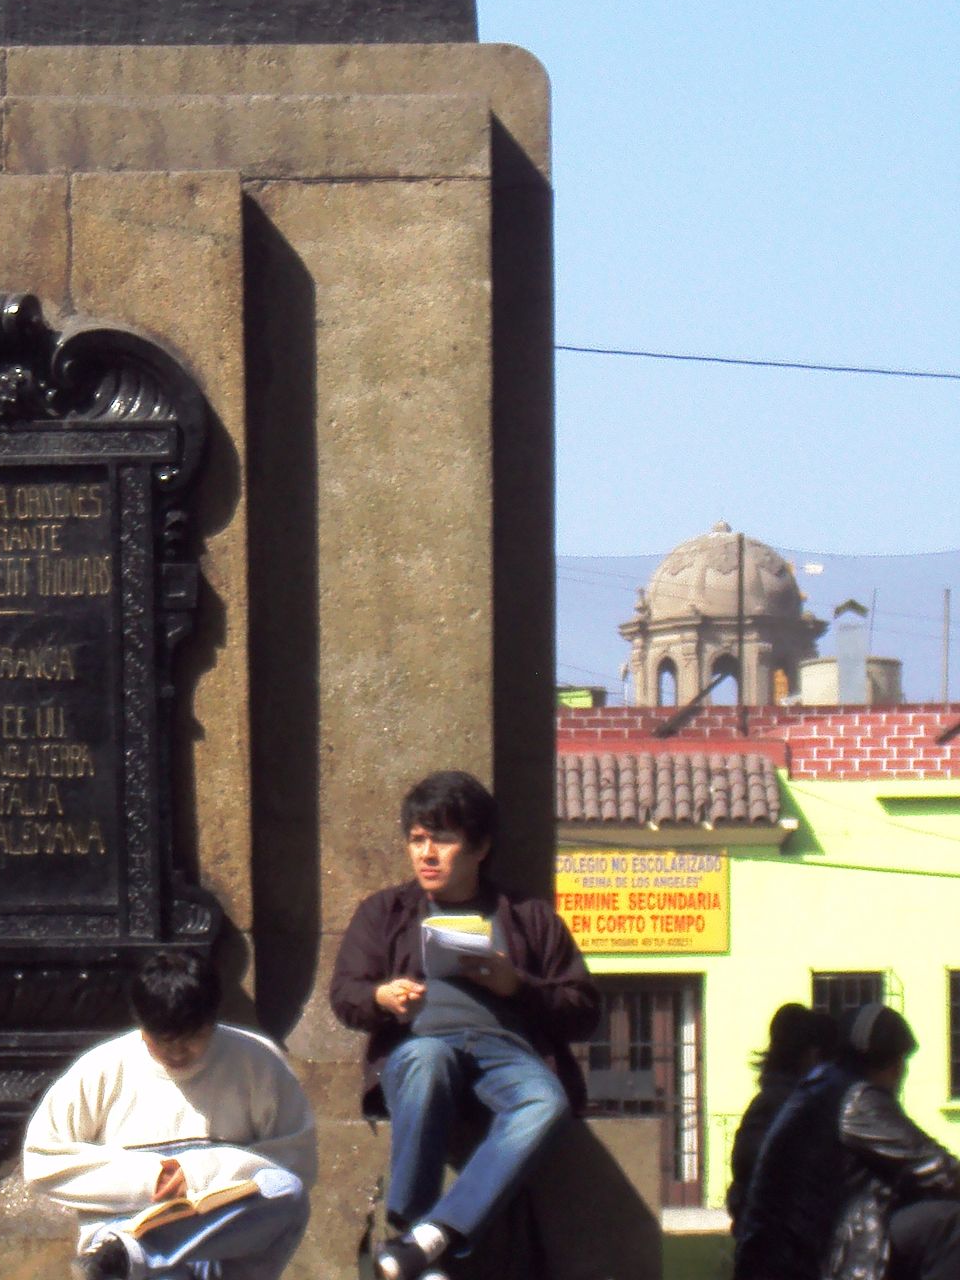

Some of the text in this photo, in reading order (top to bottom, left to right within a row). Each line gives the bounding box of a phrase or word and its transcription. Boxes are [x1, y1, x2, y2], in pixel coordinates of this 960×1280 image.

[555, 855, 722, 873] COLEGIO NO ESCOLARIZADO
[556, 892, 722, 911] TERMINE SECUNDARIA
[572, 914, 706, 933] EN CORTO TIEMPO
